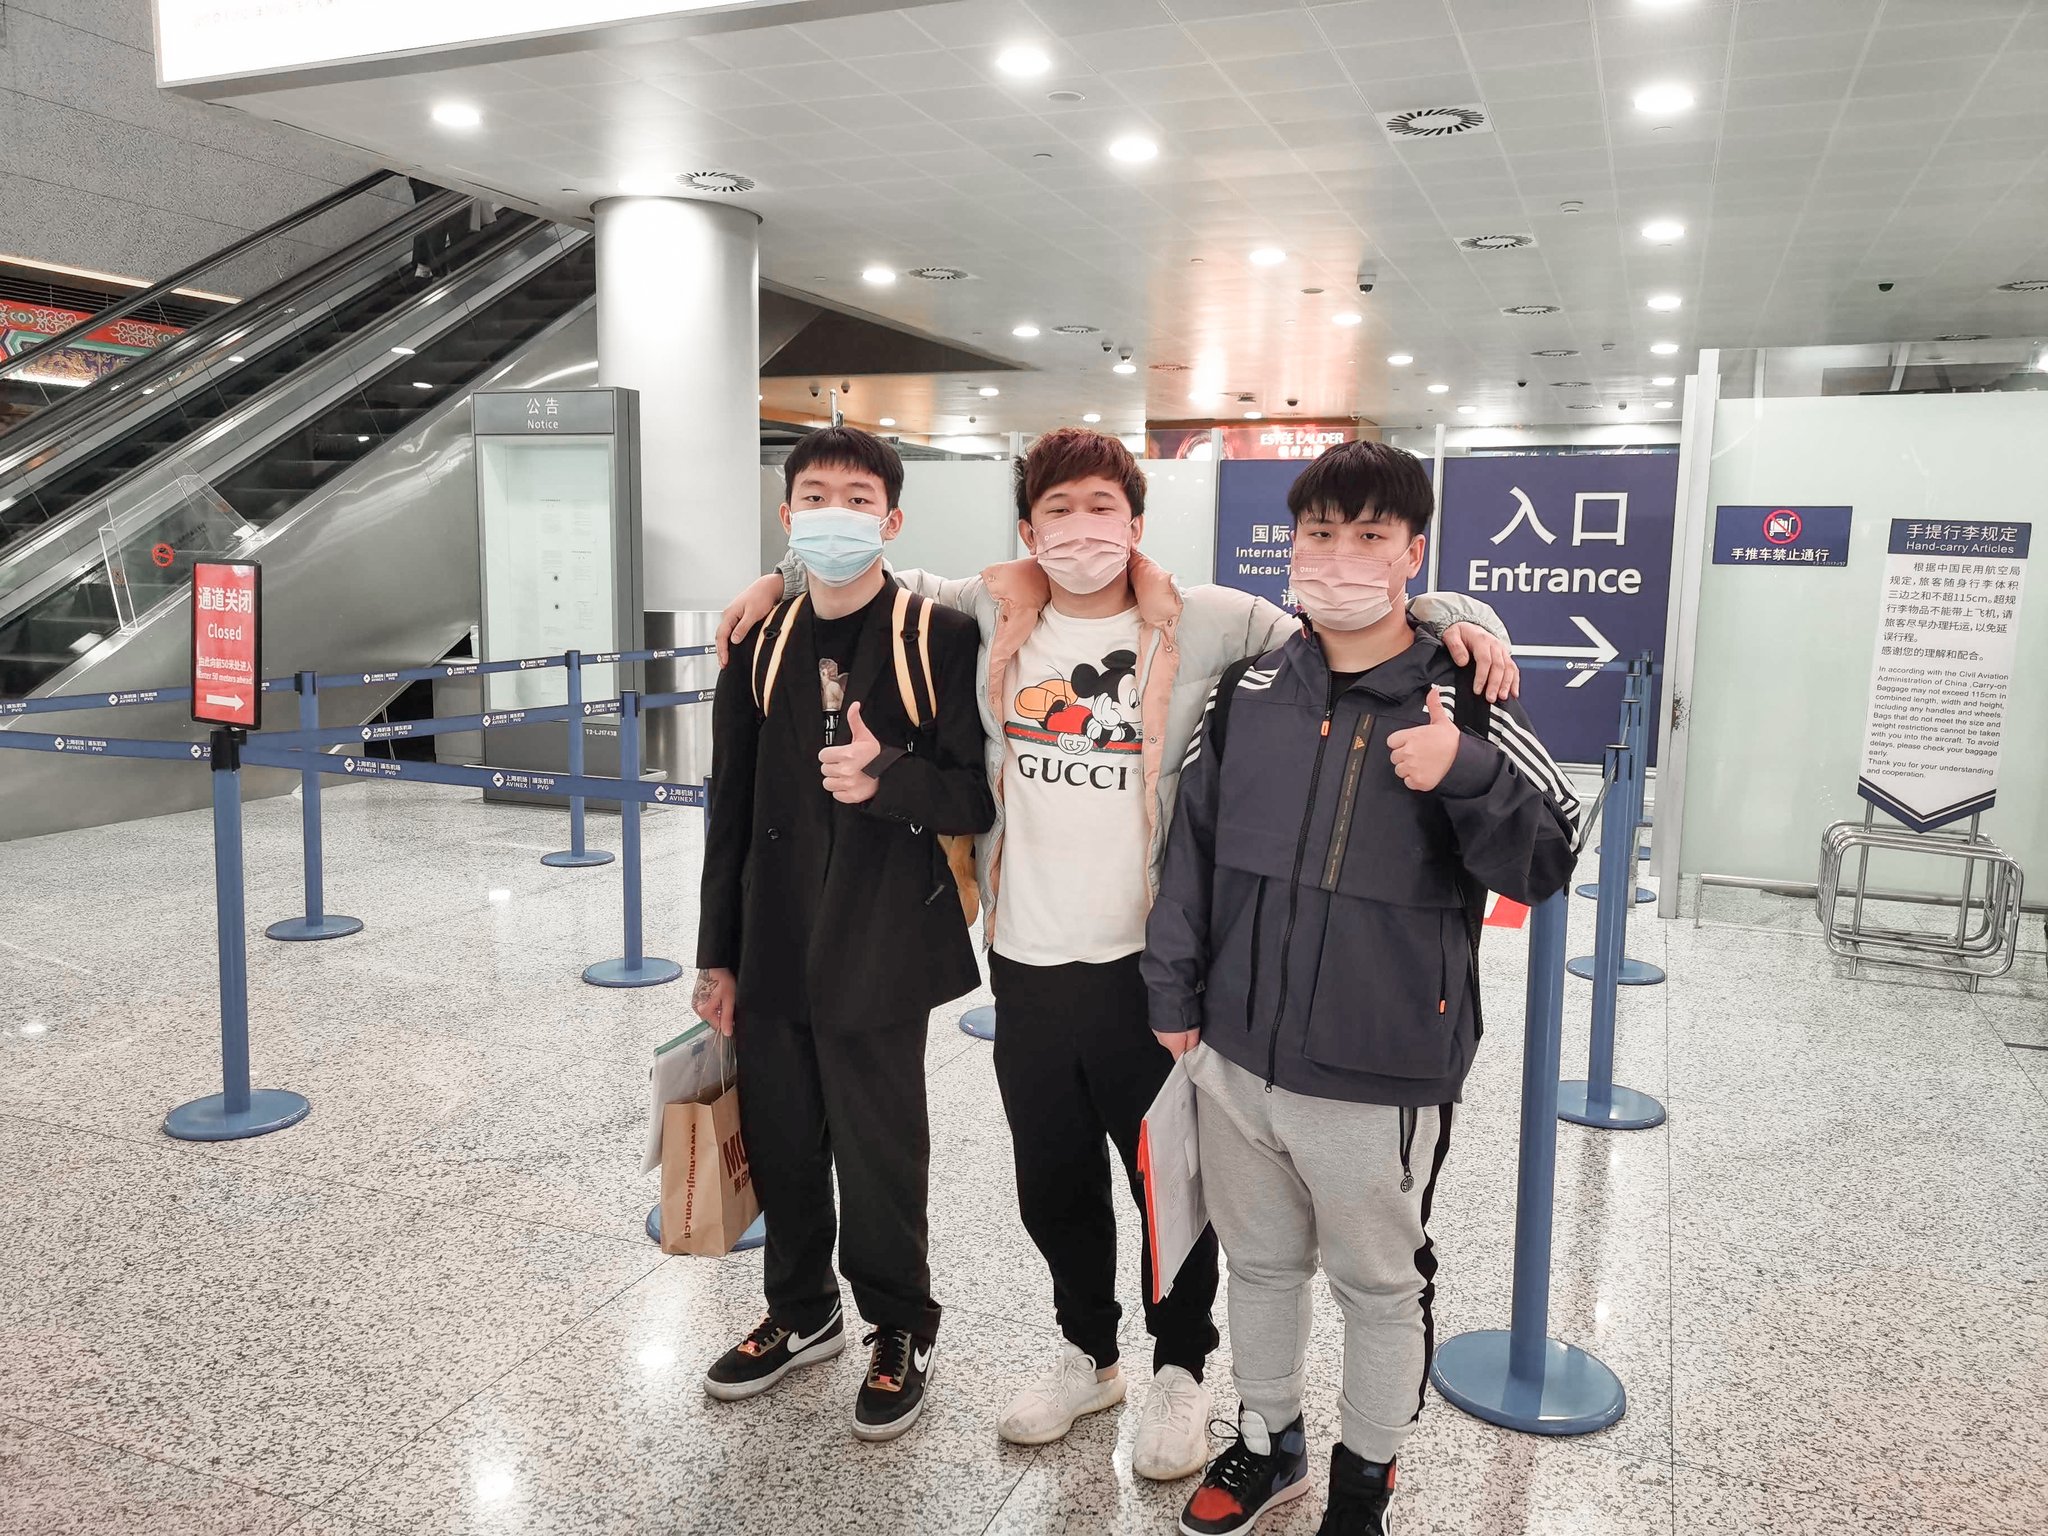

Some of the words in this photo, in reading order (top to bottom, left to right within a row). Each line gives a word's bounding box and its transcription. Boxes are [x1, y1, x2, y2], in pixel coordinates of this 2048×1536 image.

[526, 397, 559, 416] 公告
[528, 419, 559, 430] Notice
[1490, 486, 1629, 546] 入口
[1252, 524, 1290, 543] 国际
[1907, 524, 2017, 542] 手提行李规定
[1236, 547, 1293, 558] Internati
[1731, 548, 1830, 562] 手推车禁止通行
[1906, 541, 1968, 554] Hand-carry
[1971, 544, 2014, 554] Articles
[1239, 564, 1292, 575] Macau-T
[1468, 559, 1642, 594] Entrance
[1914, 562, 2020, 576] 根据中国民用航空局
[198, 586, 252, 614] 通道关闭
[1281, 589, 1300, 608] 请
[208, 623, 242, 640] Closed
[1018, 754, 1128, 790] GUCCI
[722, 1130, 747, 1179] MU
[684, 1123, 697, 1239] www.muji.com.cn
